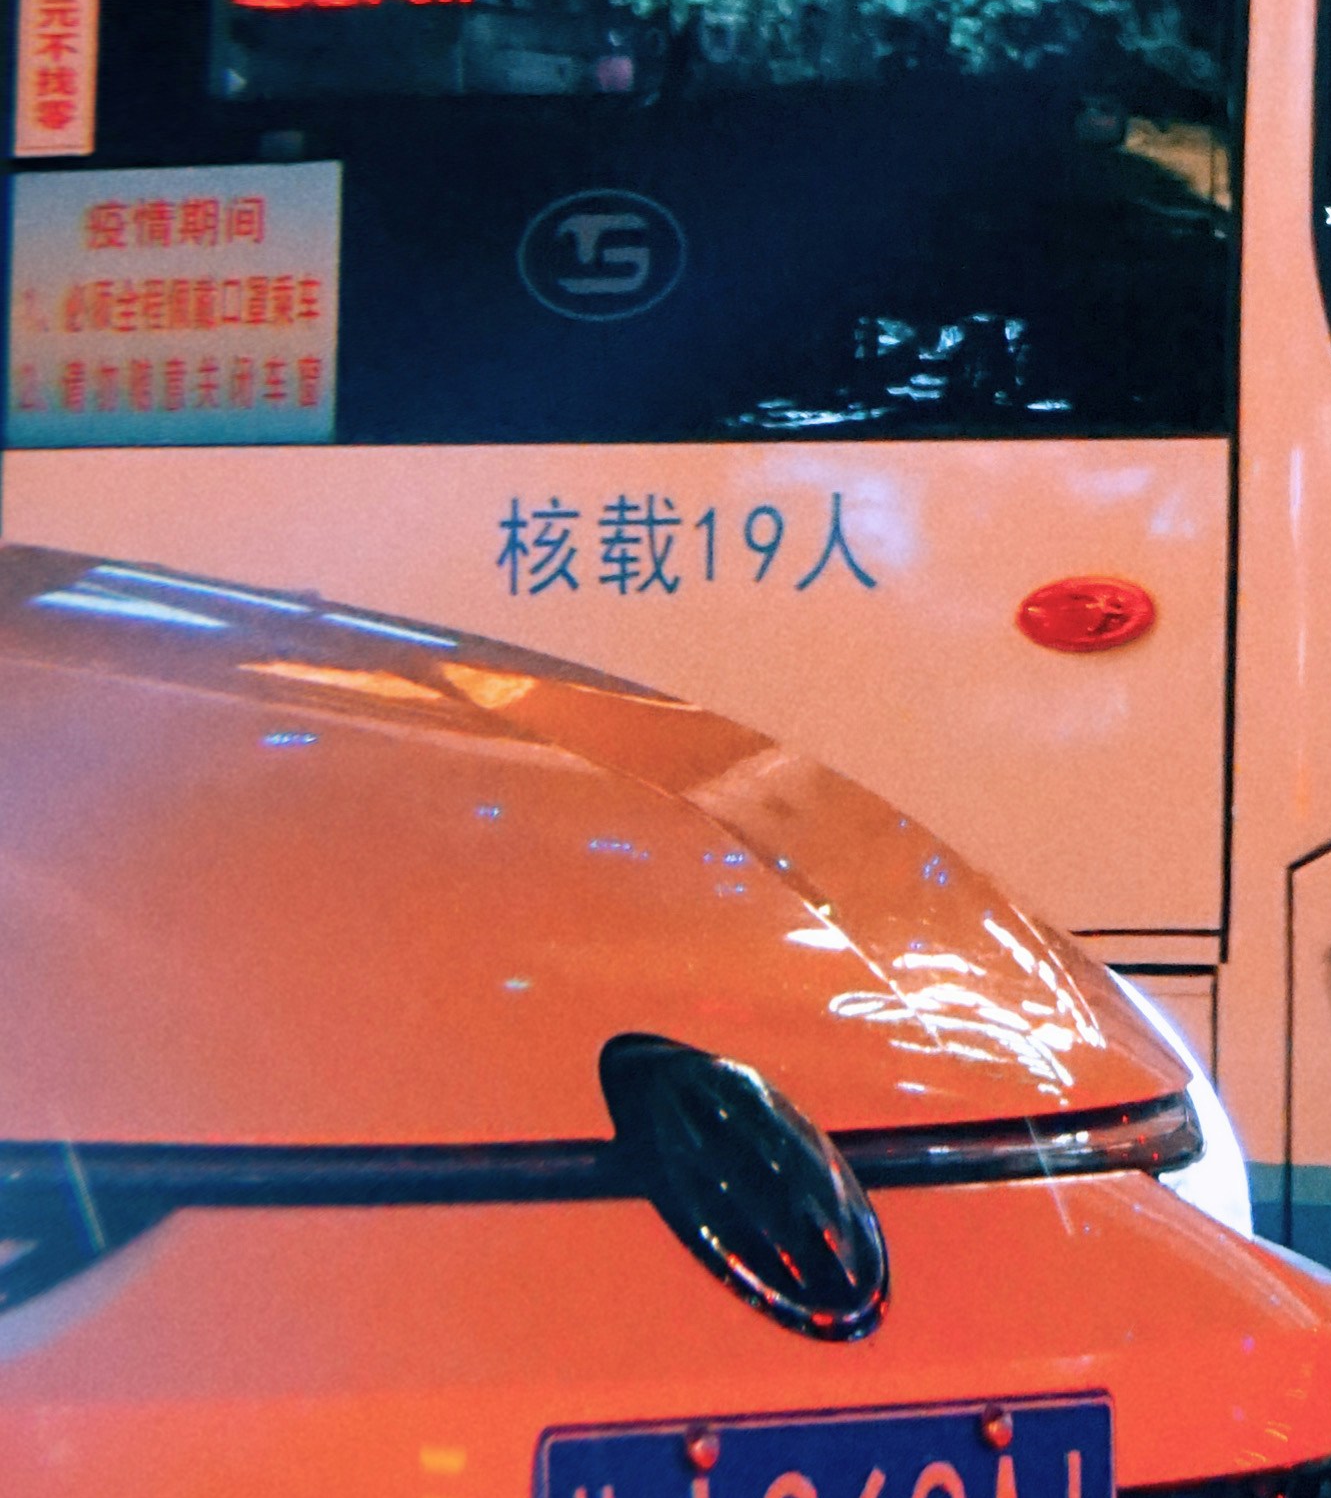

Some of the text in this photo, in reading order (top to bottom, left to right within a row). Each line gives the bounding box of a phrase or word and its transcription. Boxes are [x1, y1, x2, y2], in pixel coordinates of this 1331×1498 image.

[86, 196, 267, 249] 疫情期间
[497, 491, 880, 596] 核载19人
